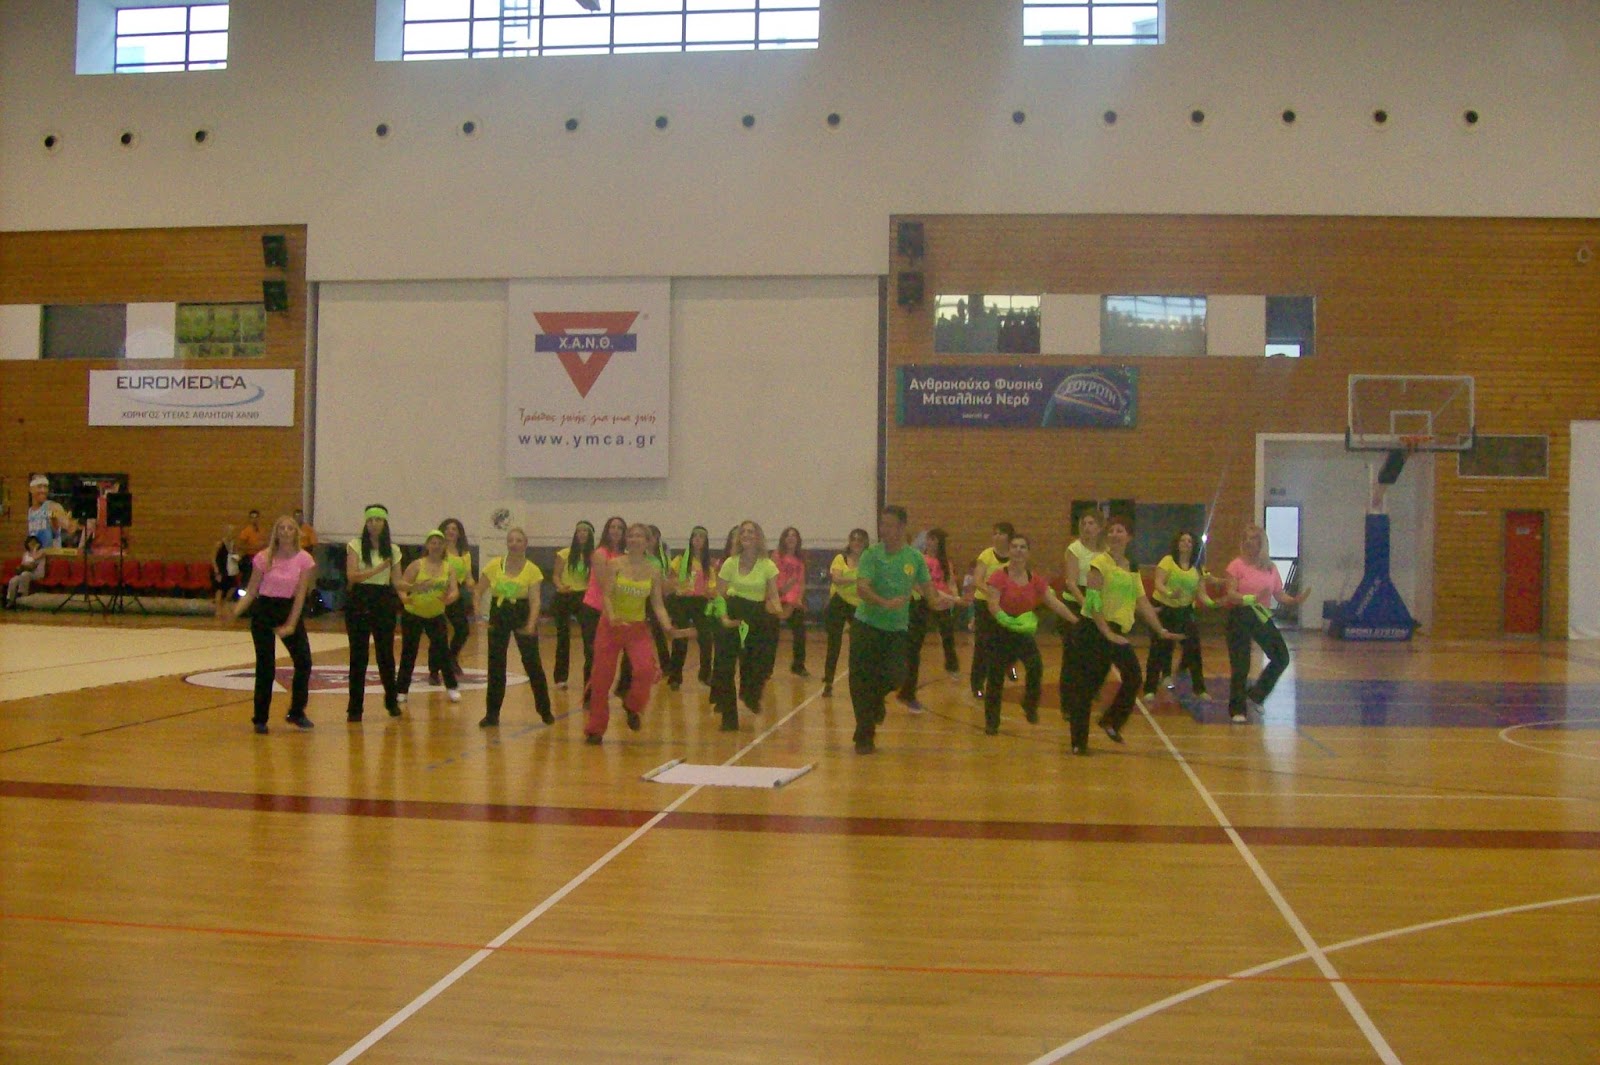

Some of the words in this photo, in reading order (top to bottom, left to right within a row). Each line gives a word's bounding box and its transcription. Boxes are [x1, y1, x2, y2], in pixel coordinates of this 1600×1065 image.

[116, 375, 247, 390] EUROMEDICA
[909, 377, 991, 393] Ανθρακούχο
[994, 378, 1043, 391] Φυσικό
[922, 391, 993, 406] Μεταλλικό
[995, 392, 1030, 408] Νερό
[518, 434, 657, 449] www.ymca.gr
